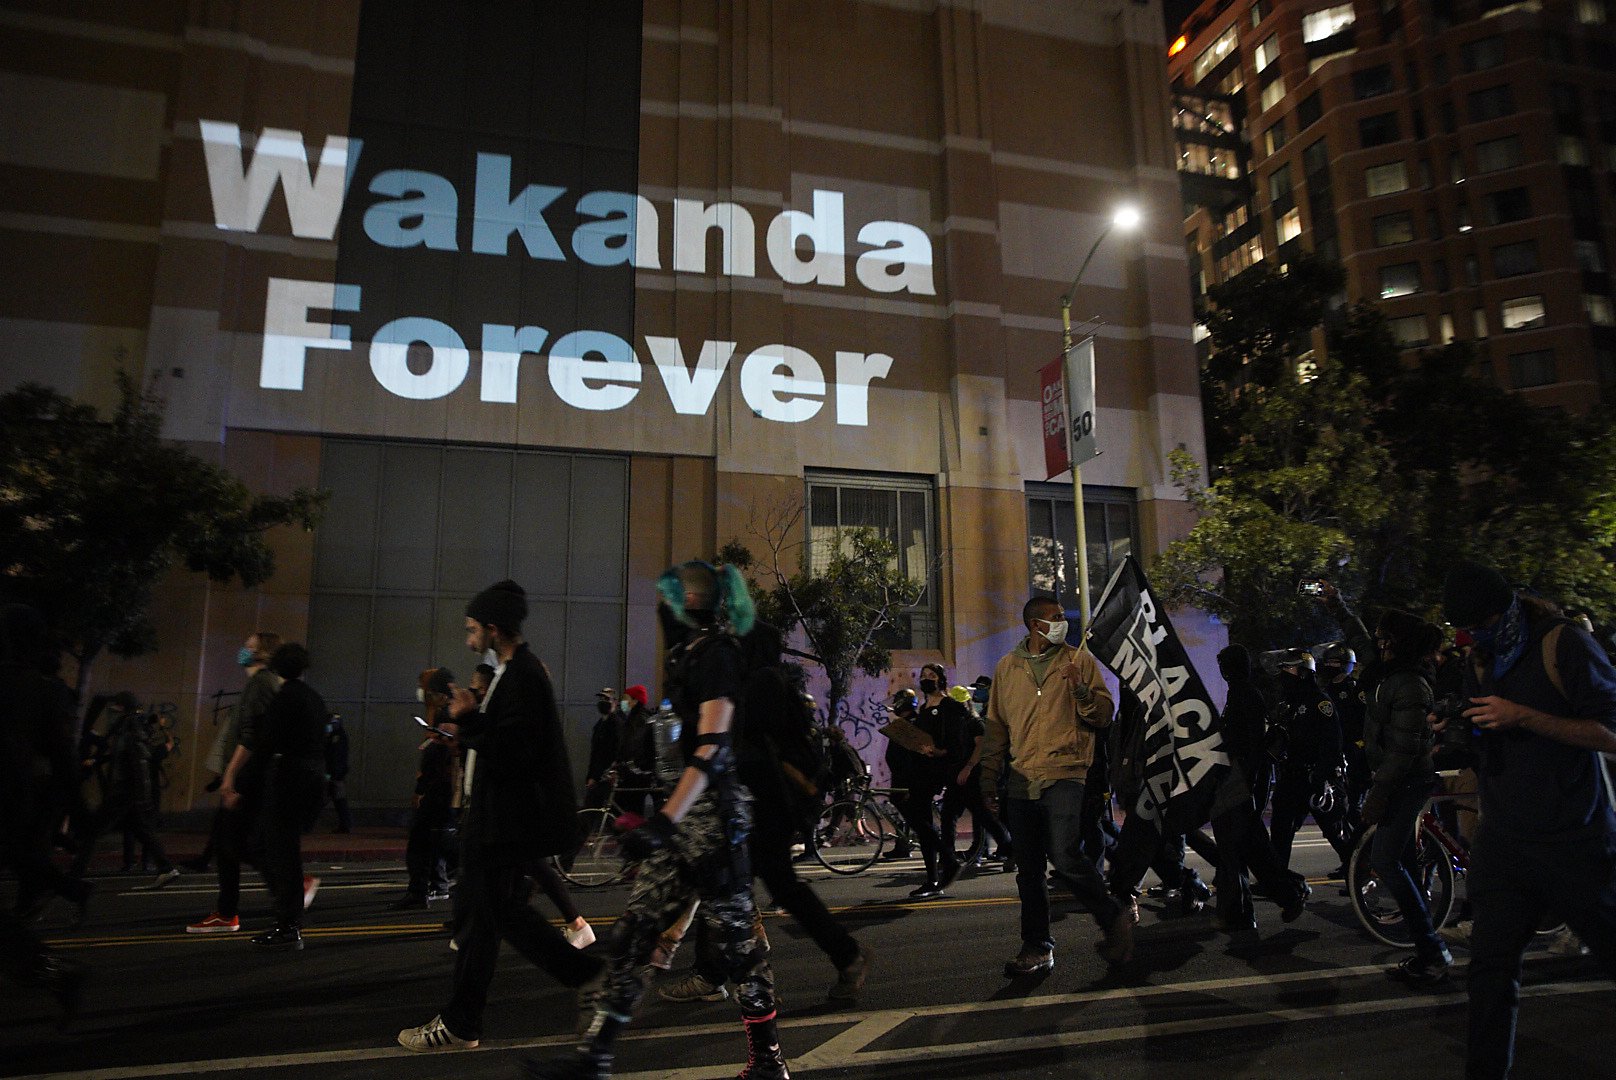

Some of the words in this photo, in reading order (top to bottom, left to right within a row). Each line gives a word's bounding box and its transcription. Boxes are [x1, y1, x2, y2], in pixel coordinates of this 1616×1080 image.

[199, 119, 937, 297] Wakanda
[259, 276, 895, 427] Forever
[1073, 411, 1092, 442] 50
